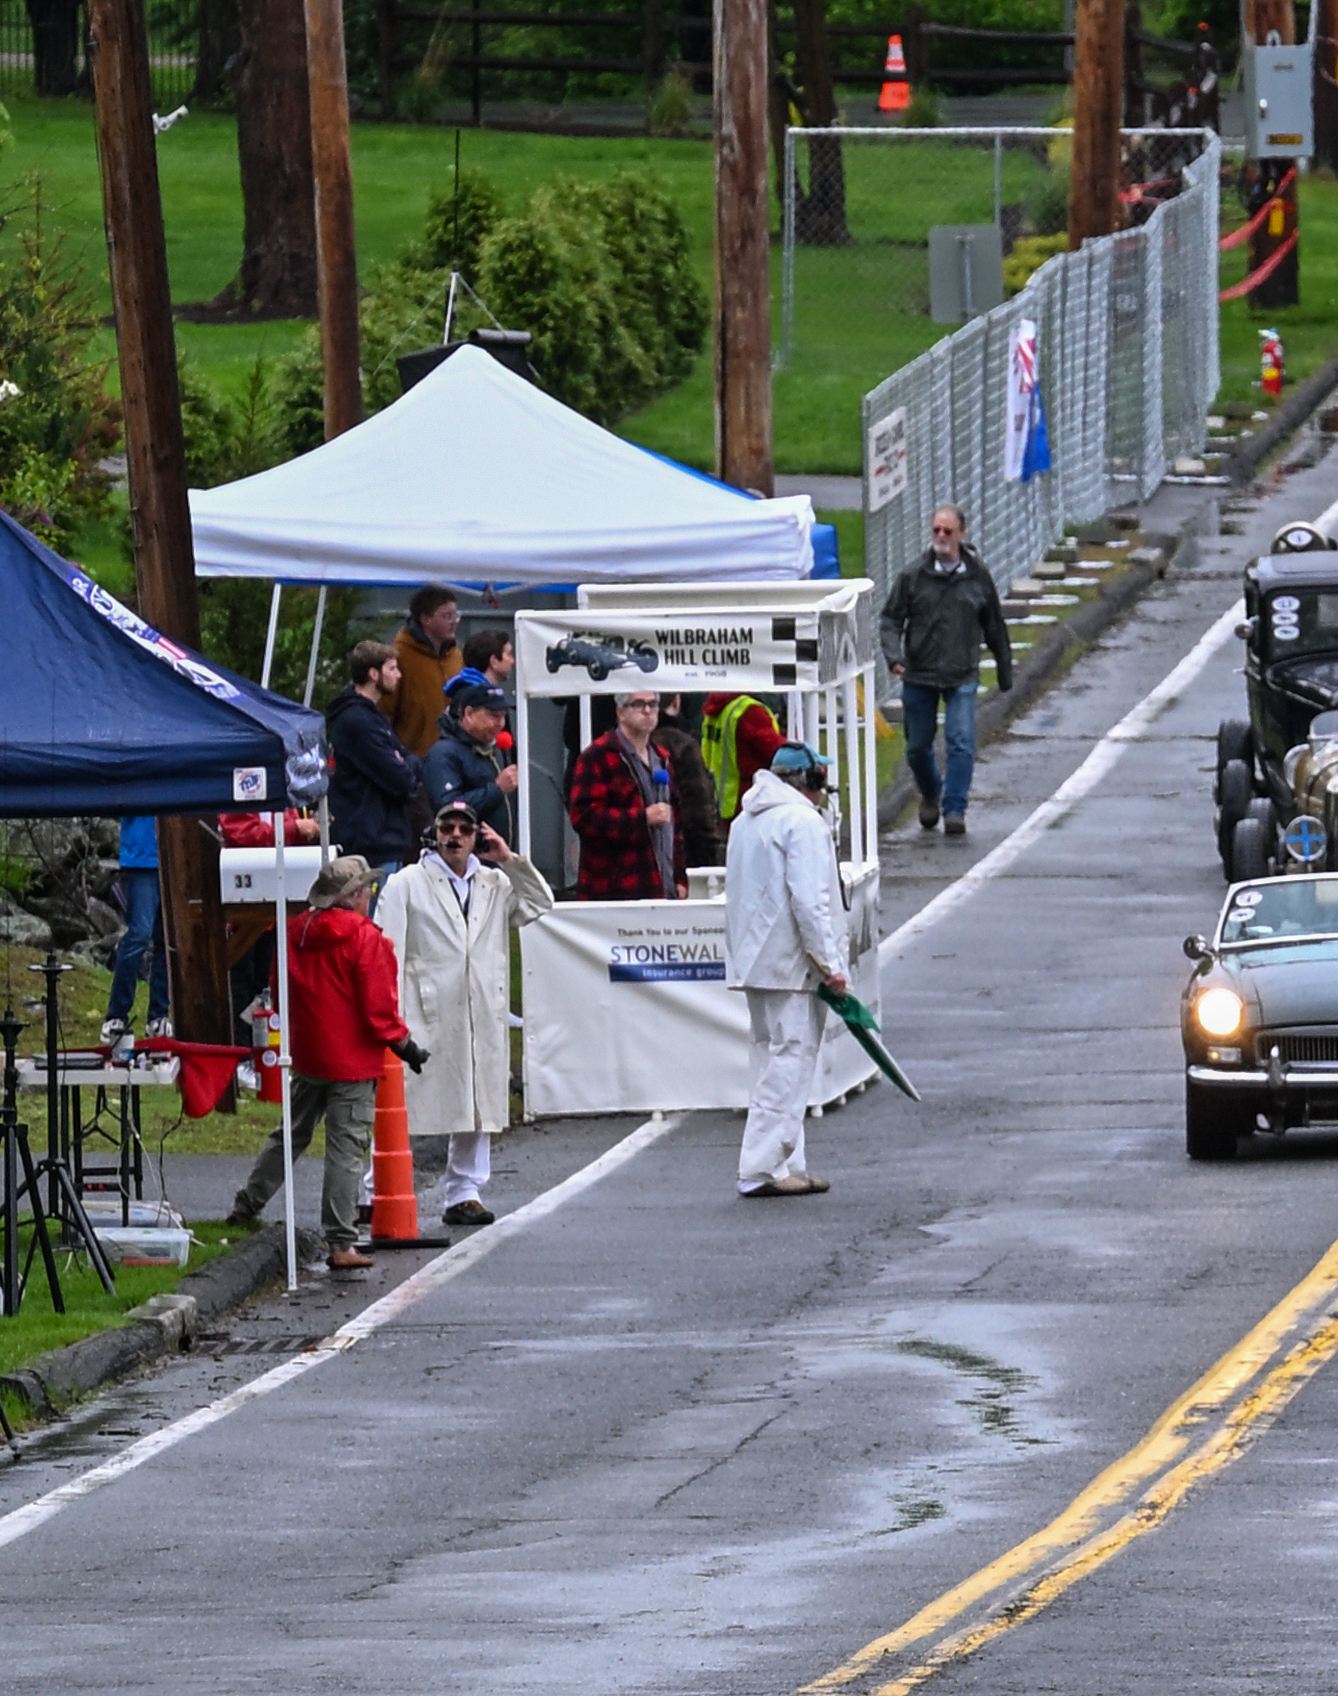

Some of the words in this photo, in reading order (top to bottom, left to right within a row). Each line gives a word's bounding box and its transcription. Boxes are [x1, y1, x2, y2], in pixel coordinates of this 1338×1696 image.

[655, 628, 753, 646] WILBRAHAM
[664, 649, 698, 666] HILL
[702, 648, 751, 666] CLIMB
[234, 873, 253, 889] 33
[616, 927, 644, 937] Thank
[646, 927, 661, 936] You
[662, 927, 673, 936] to
[692, 926, 727, 937] Sponso
[610, 943, 725, 963] STONEWAL
